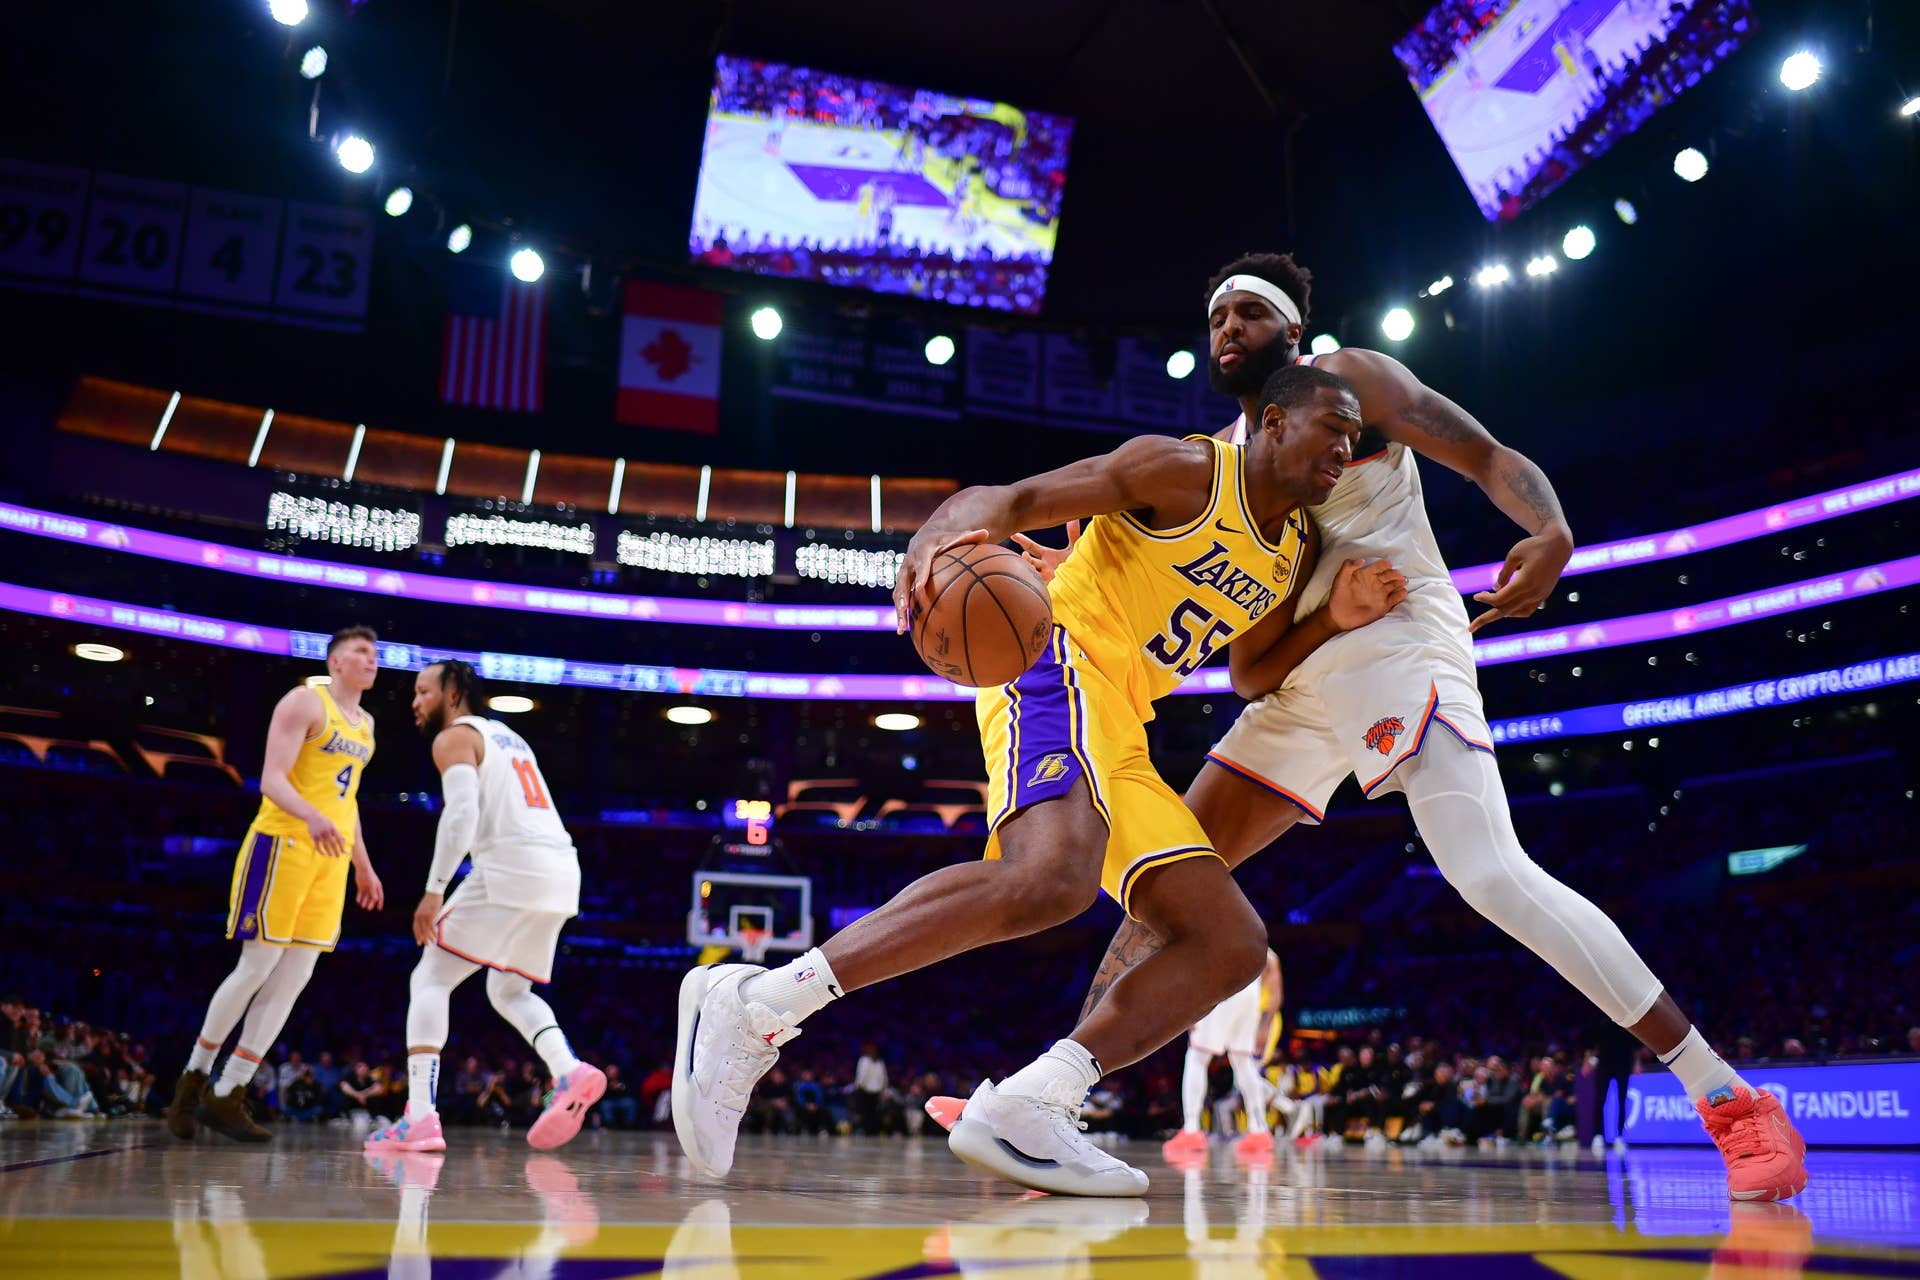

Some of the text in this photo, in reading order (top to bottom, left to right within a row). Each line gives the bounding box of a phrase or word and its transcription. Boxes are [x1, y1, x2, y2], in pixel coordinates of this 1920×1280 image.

[96, 217, 169, 270] 20
[210, 235, 244, 284] 4
[295, 244, 357, 297] 23
[1171, 540, 1277, 621] LAKERS
[1140, 598, 1235, 679] 55
[1622, 695, 1693, 727] OFFICIAL
[1694, 686, 1753, 718] AIRLINE
[1754, 681, 1775, 706] OF
[1776, 661, 1883, 702] CRYPTO.COM
[1366, 716, 1405, 750] KNICKS
[1506, 717, 1563, 740] DELTA
[337, 764, 353, 797] 4
[511, 757, 549, 809] 11
[748, 818, 767, 845] 6
[1793, 1090, 1909, 1119] FANDUEL
